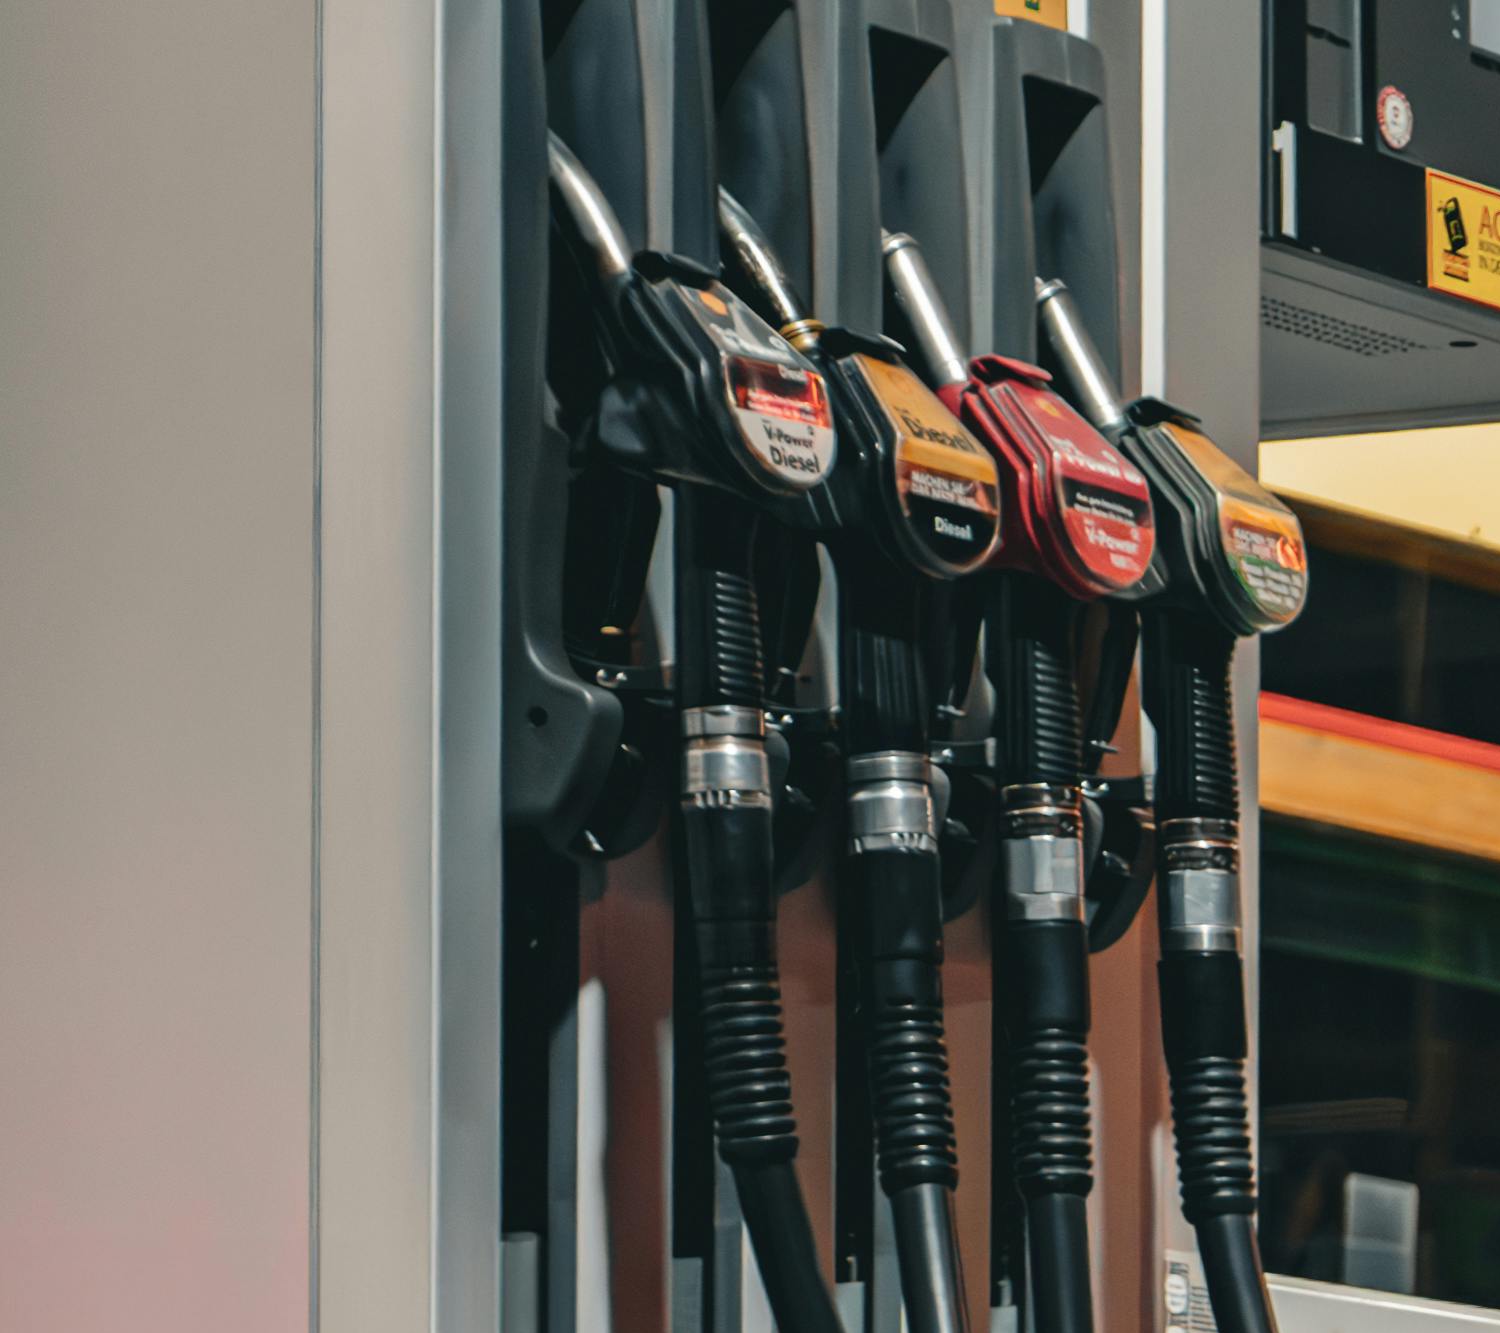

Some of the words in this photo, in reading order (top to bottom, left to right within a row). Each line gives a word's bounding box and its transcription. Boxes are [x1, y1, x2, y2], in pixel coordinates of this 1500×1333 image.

[1272, 119, 1296, 238] 1
[769, 445, 820, 474] Diesel
[935, 516, 973, 541] Diesel
